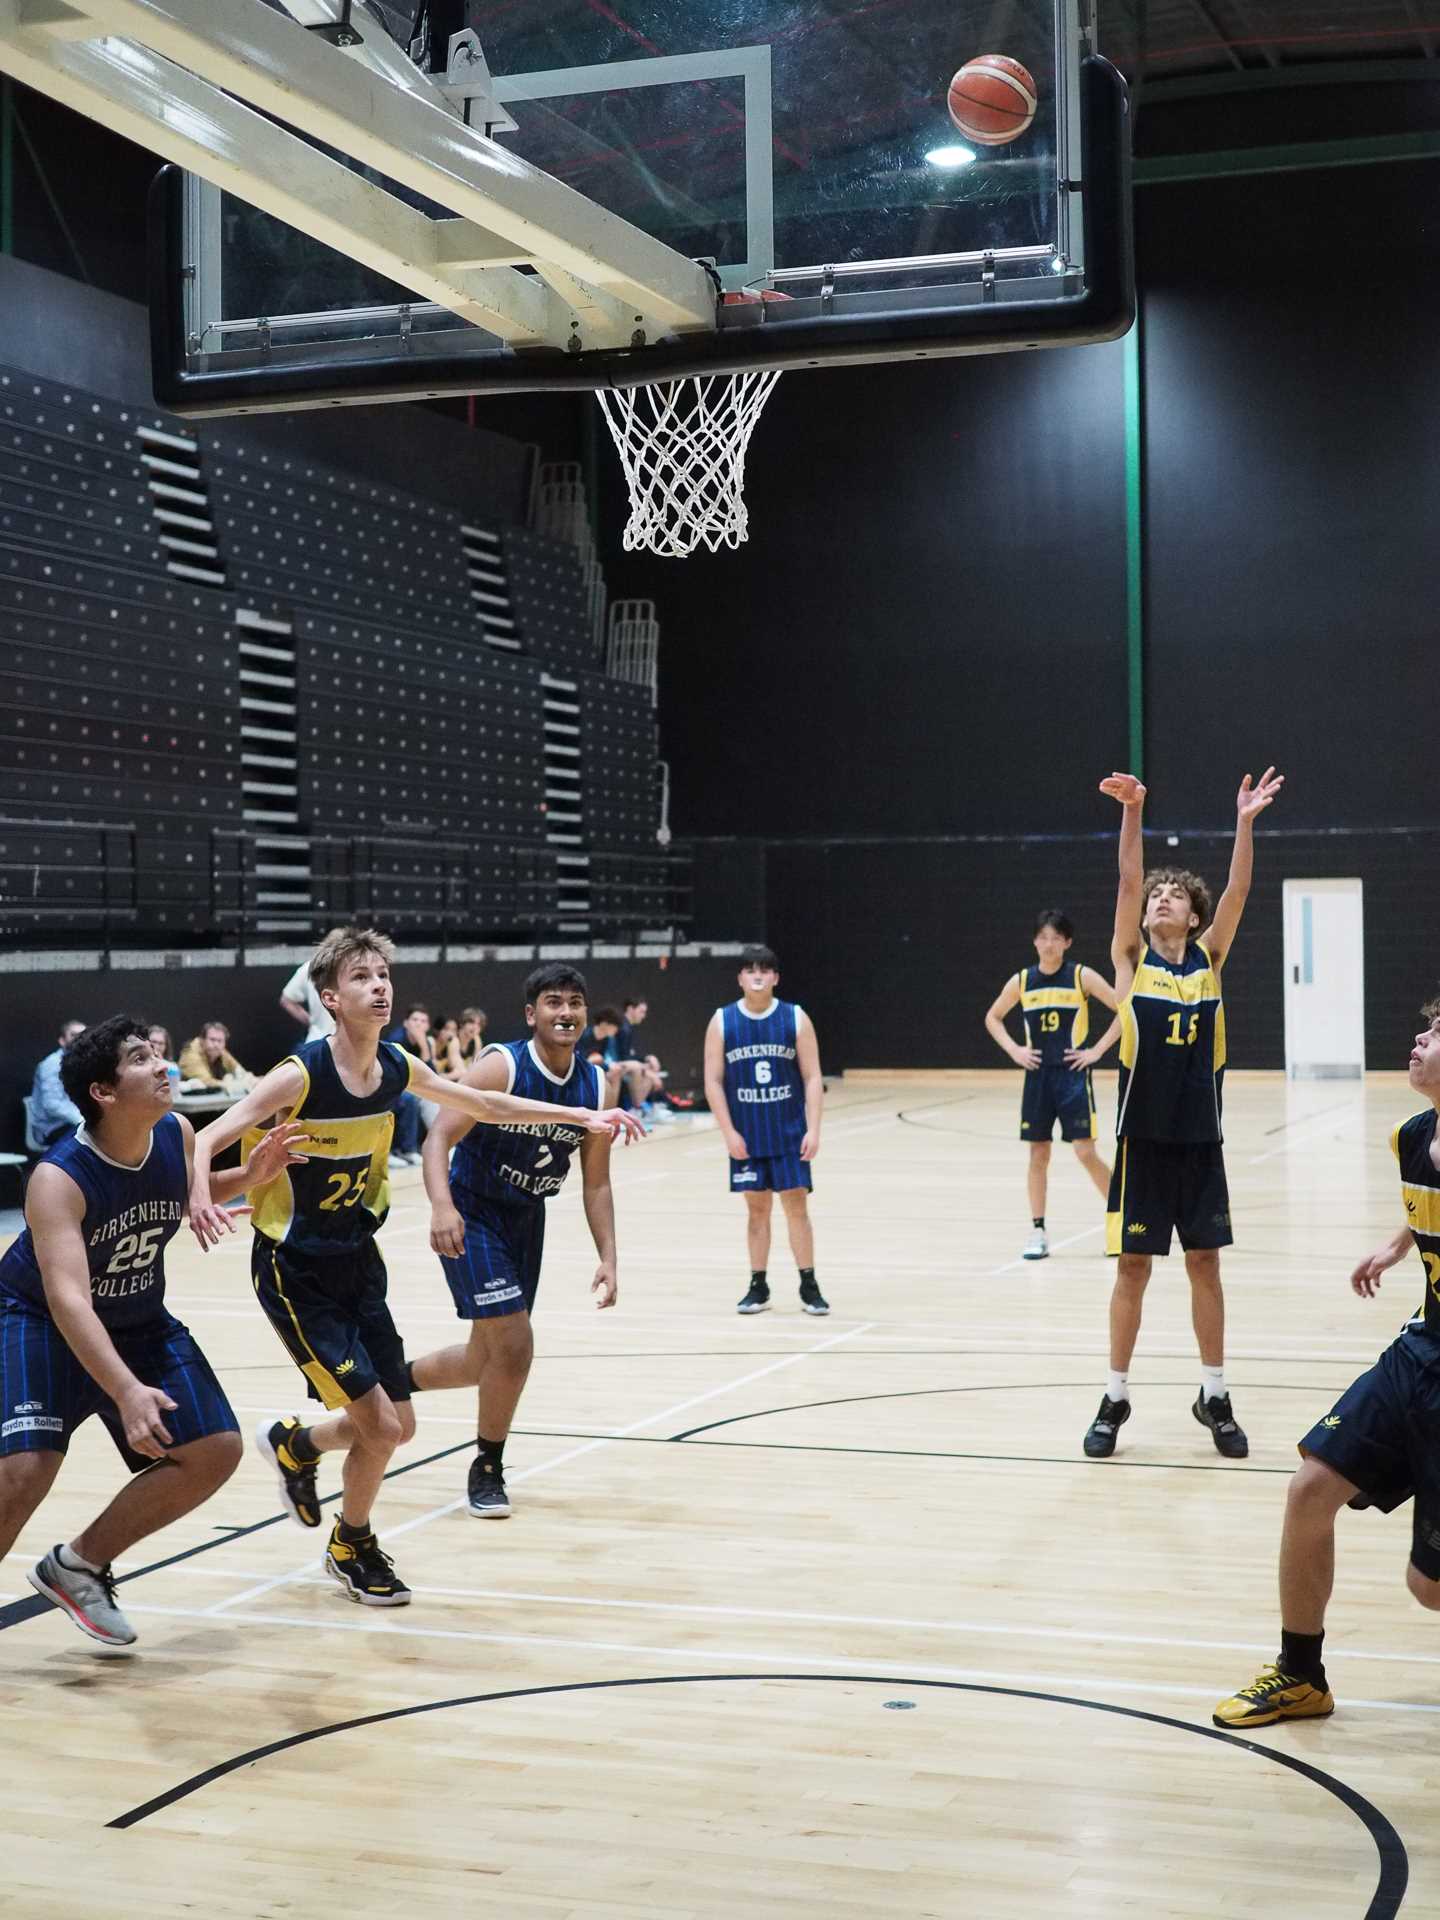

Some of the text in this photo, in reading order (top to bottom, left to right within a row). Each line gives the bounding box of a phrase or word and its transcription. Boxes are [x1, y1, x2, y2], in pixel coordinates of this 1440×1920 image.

[1040, 1011, 1060, 1032] 19
[726, 1044, 796, 1063] BIRKENHEAD
[755, 1061, 772, 1084] 6
[737, 1085, 792, 1103] COLLEGE
[319, 1168, 369, 1211] 25
[90, 1201, 181, 1246] BIRKENHEAD
[106, 1227, 163, 1273] 25
[89, 1265, 155, 1297] COLLEGE
